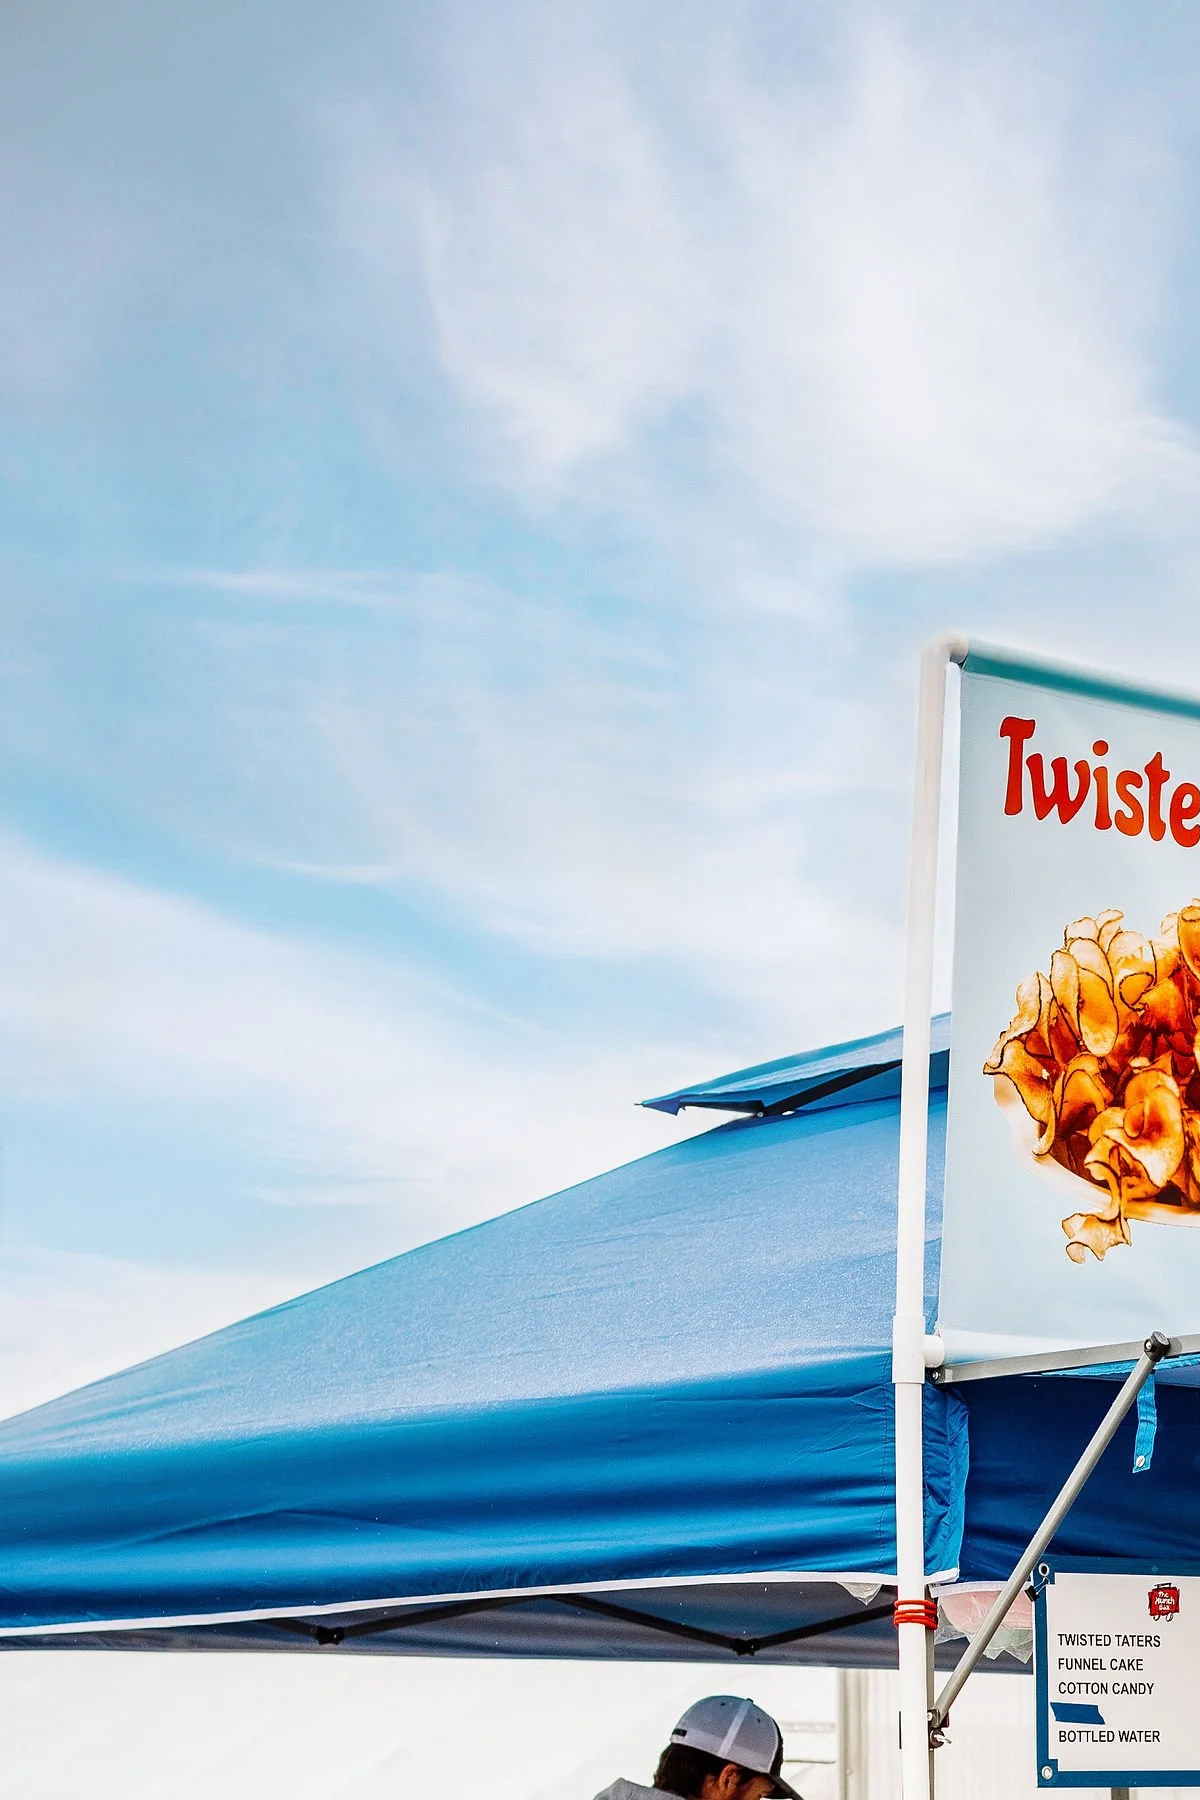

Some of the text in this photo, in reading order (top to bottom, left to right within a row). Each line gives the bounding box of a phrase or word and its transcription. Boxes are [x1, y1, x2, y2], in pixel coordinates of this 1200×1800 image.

[1057, 1633, 1112, 1648] TWISTED
[1114, 1634, 1161, 1648] TATERS
[1058, 1658, 1106, 1671] FUNNEL
[1110, 1658, 1144, 1672] CAKE
[1058, 1682, 1108, 1695] COTTON
[1112, 1682, 1154, 1696] CANDY
[1058, 1730, 1116, 1743] BOTTLED
[1118, 1730, 1160, 1743] WATER
